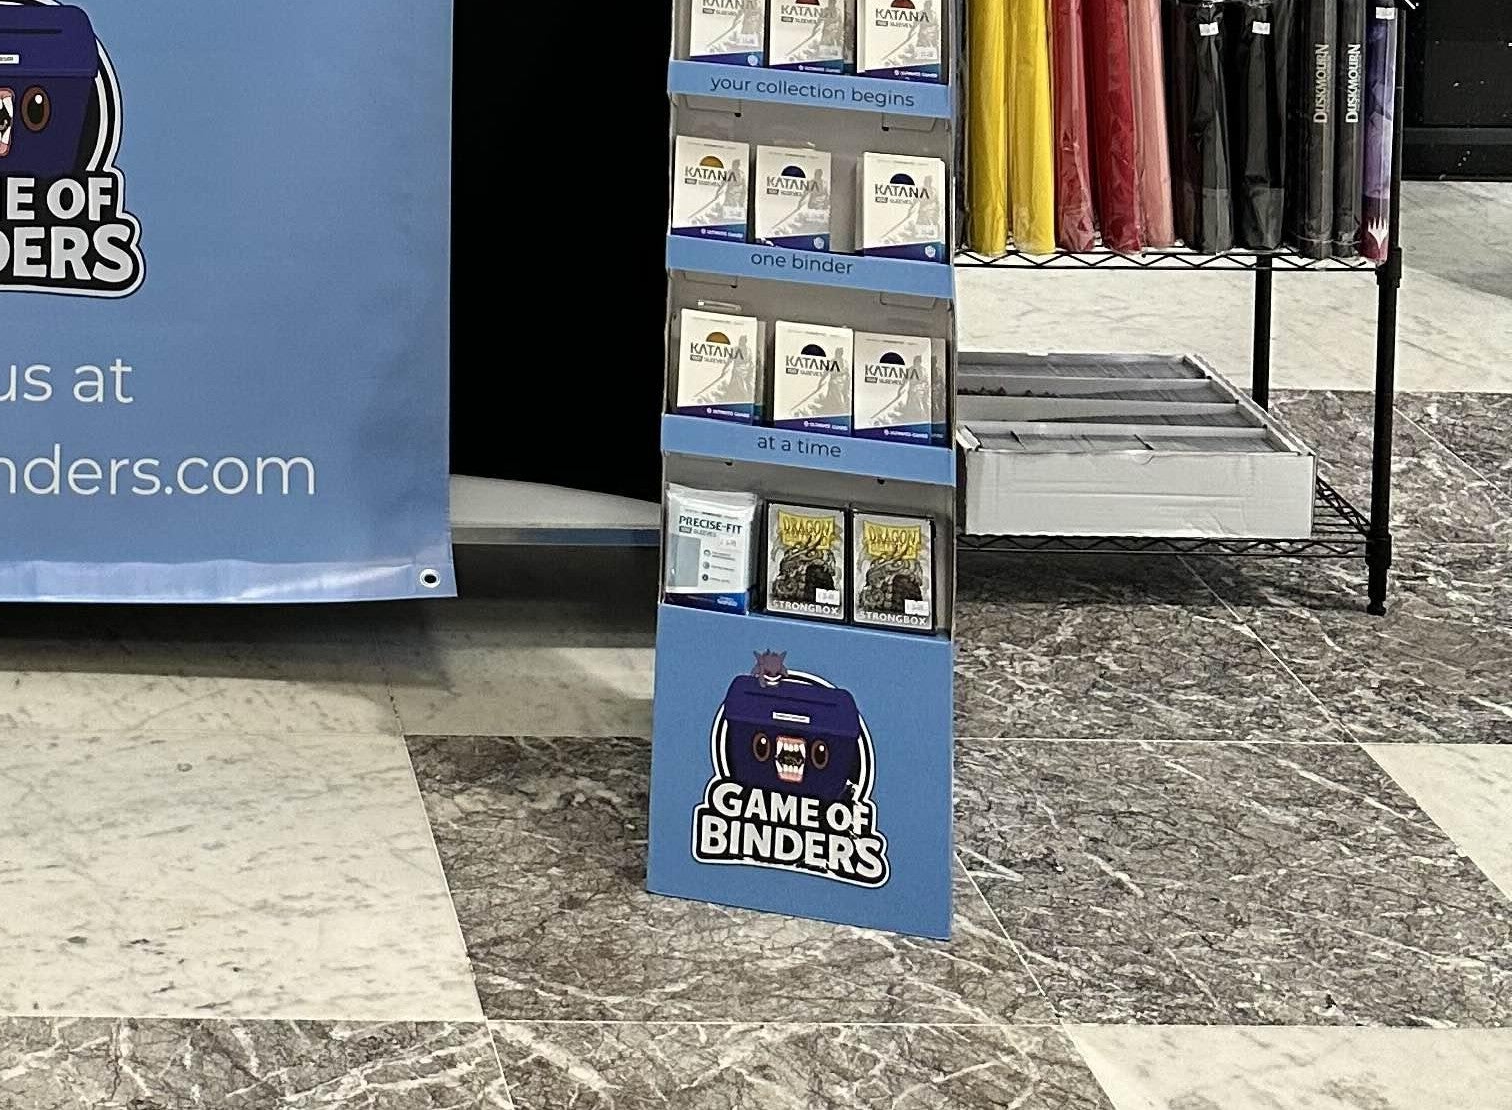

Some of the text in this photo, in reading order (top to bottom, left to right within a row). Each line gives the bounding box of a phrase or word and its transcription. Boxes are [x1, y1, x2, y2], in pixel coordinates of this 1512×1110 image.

[780, 4, 833, 19] KATANA
[875, 8, 930, 23] KATANA
[710, 76, 915, 108] your collection begins
[1313, 43, 1330, 124] DUSKMOURN
[1346, 44, 1361, 124] DUSKMOURN
[685, 166, 737, 182] KATANA
[766, 176, 820, 192] KATANA
[874, 183, 930, 200] KATANA
[46, 177, 113, 222] OF
[751, 251, 854, 275] one binder
[690, 342, 744, 360] KATANA
[785, 354, 840, 373] KATANA
[864, 364, 920, 380] KATANA
[73, 358, 134, 404] at
[757, 434, 842, 458] at a time
[679, 515, 743, 535] PRECISE-FIT
[782, 518, 832, 536] DRAGON
[868, 528, 918, 546] DRAGON
[772, 600, 839, 616] STRONGBOX
[859, 610, 927, 626] STRONGBOX
[712, 782, 870, 834] GAME OF
[700, 814, 883, 879] BINDERS
